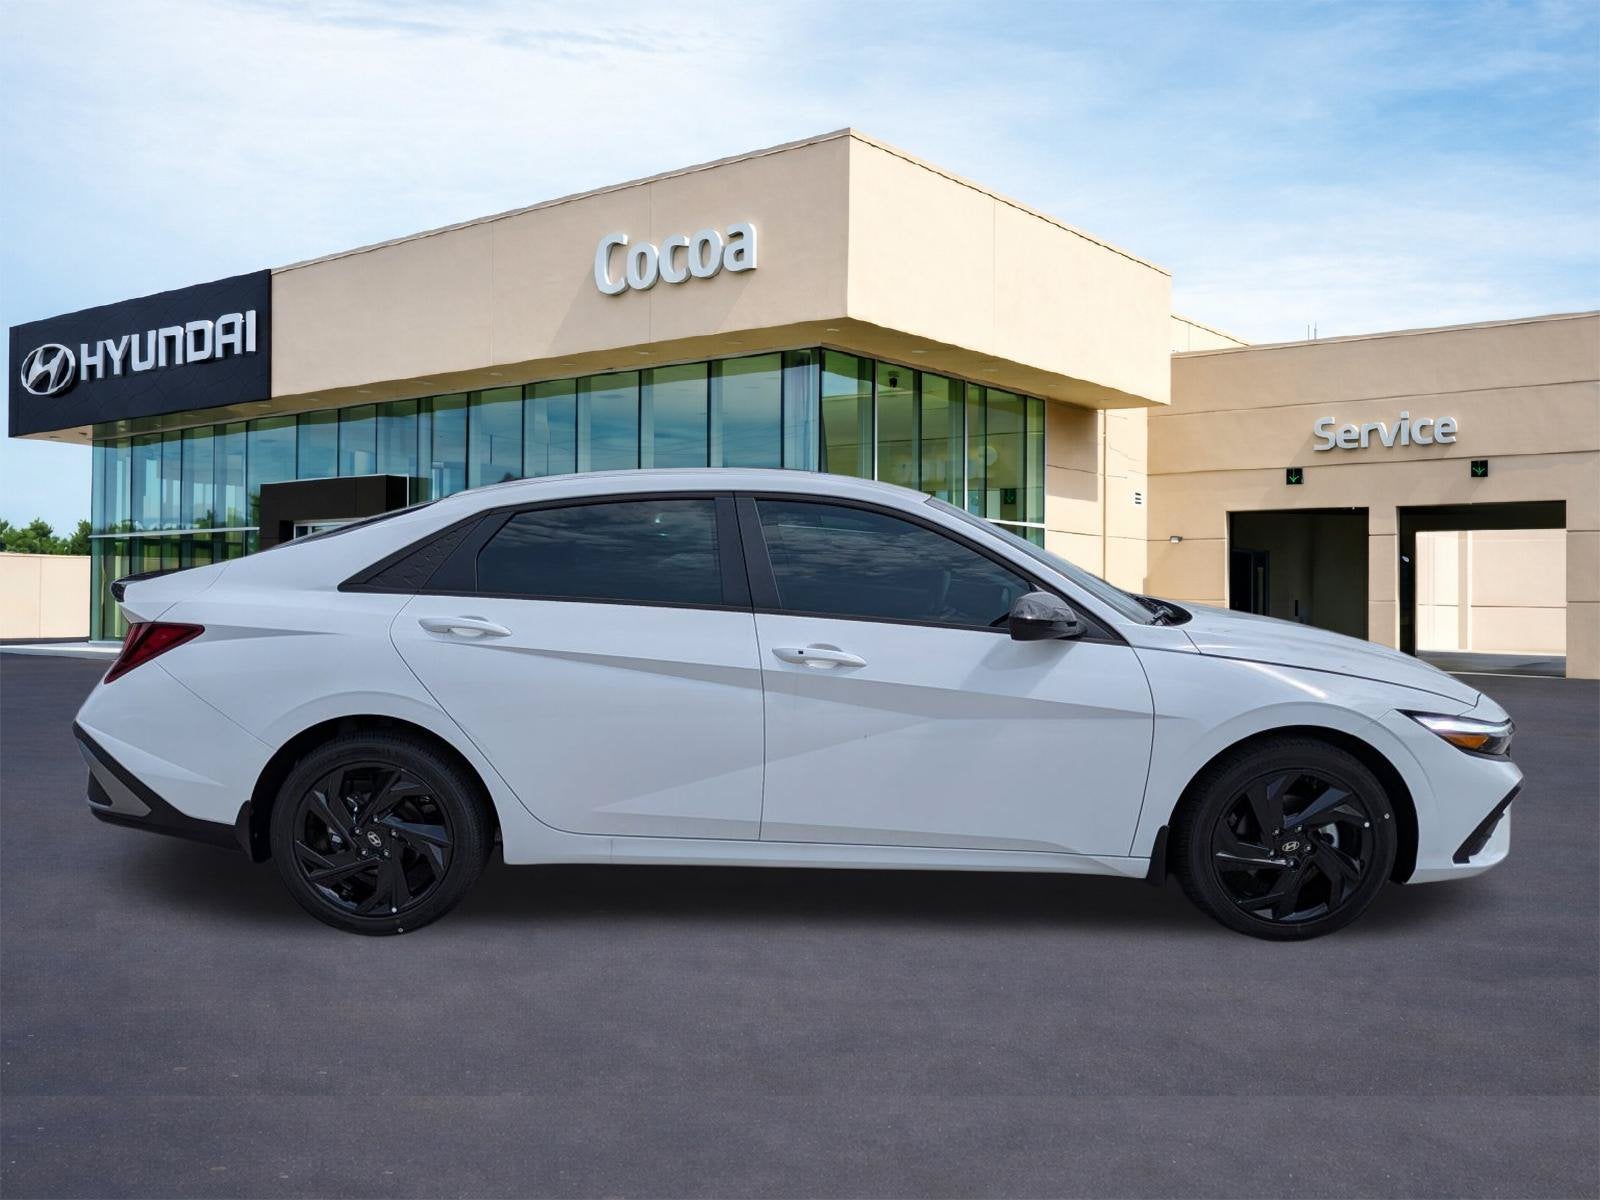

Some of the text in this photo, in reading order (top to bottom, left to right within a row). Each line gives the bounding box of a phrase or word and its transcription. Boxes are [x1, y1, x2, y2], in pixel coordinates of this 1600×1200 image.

[594, 222, 758, 296] Cocoa
[80, 310, 257, 381] HYUNDAI
[1313, 411, 1458, 451] Service
